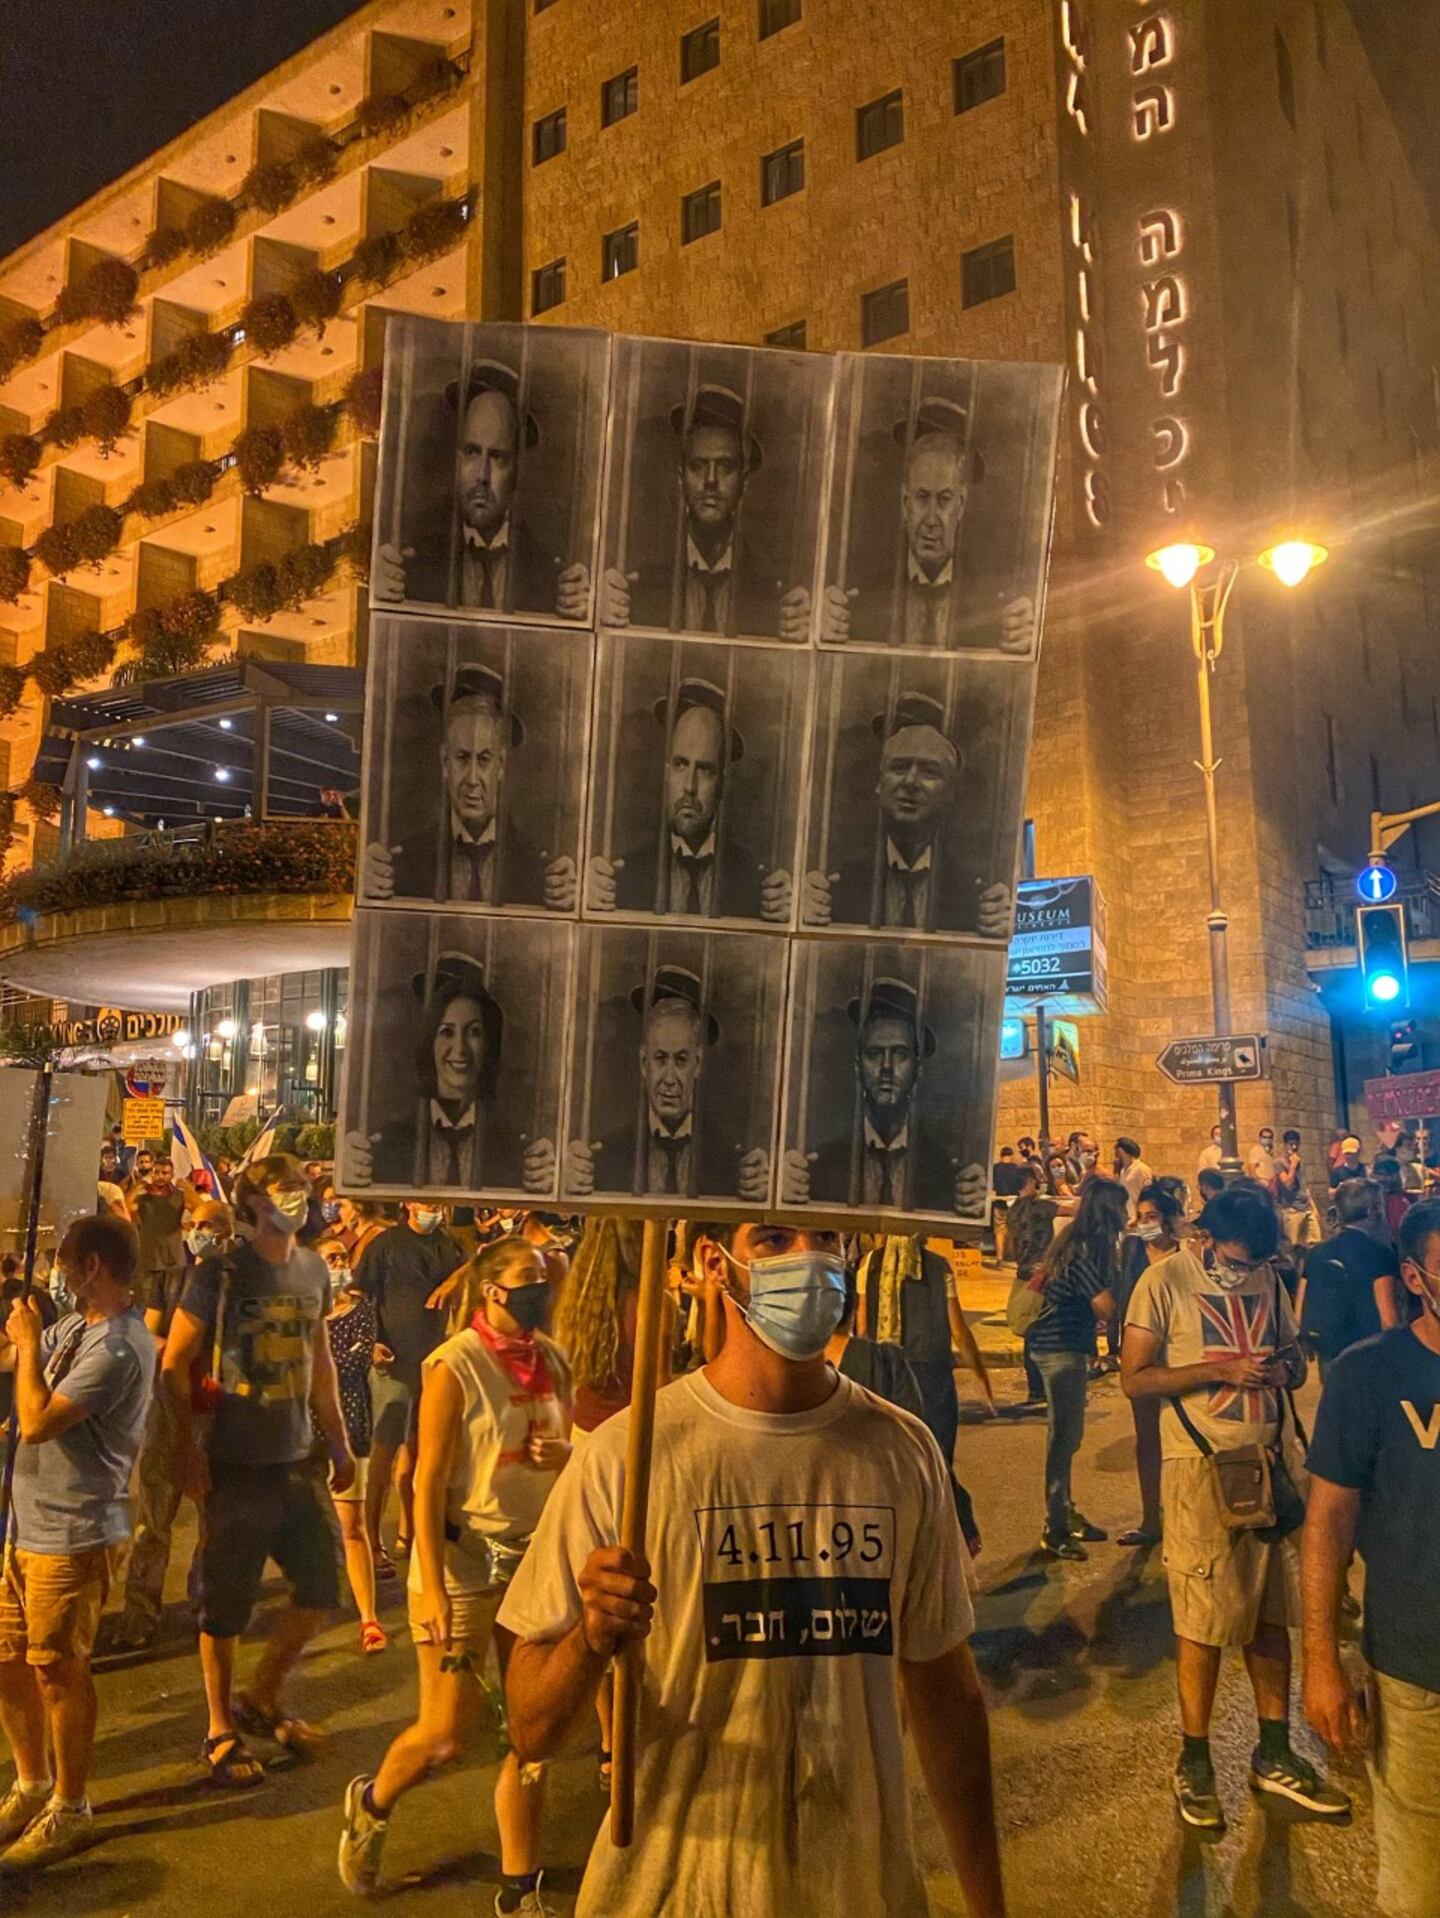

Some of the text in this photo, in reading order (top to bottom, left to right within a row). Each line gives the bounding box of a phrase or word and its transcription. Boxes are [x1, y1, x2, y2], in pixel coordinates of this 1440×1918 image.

[1016, 908, 1070, 922] USEUM
[1176, 1067, 1233, 1079] Prima Kings
[717, 1520, 883, 1565] 4.11.95
[799, 1591, 888, 1645] שלום,
